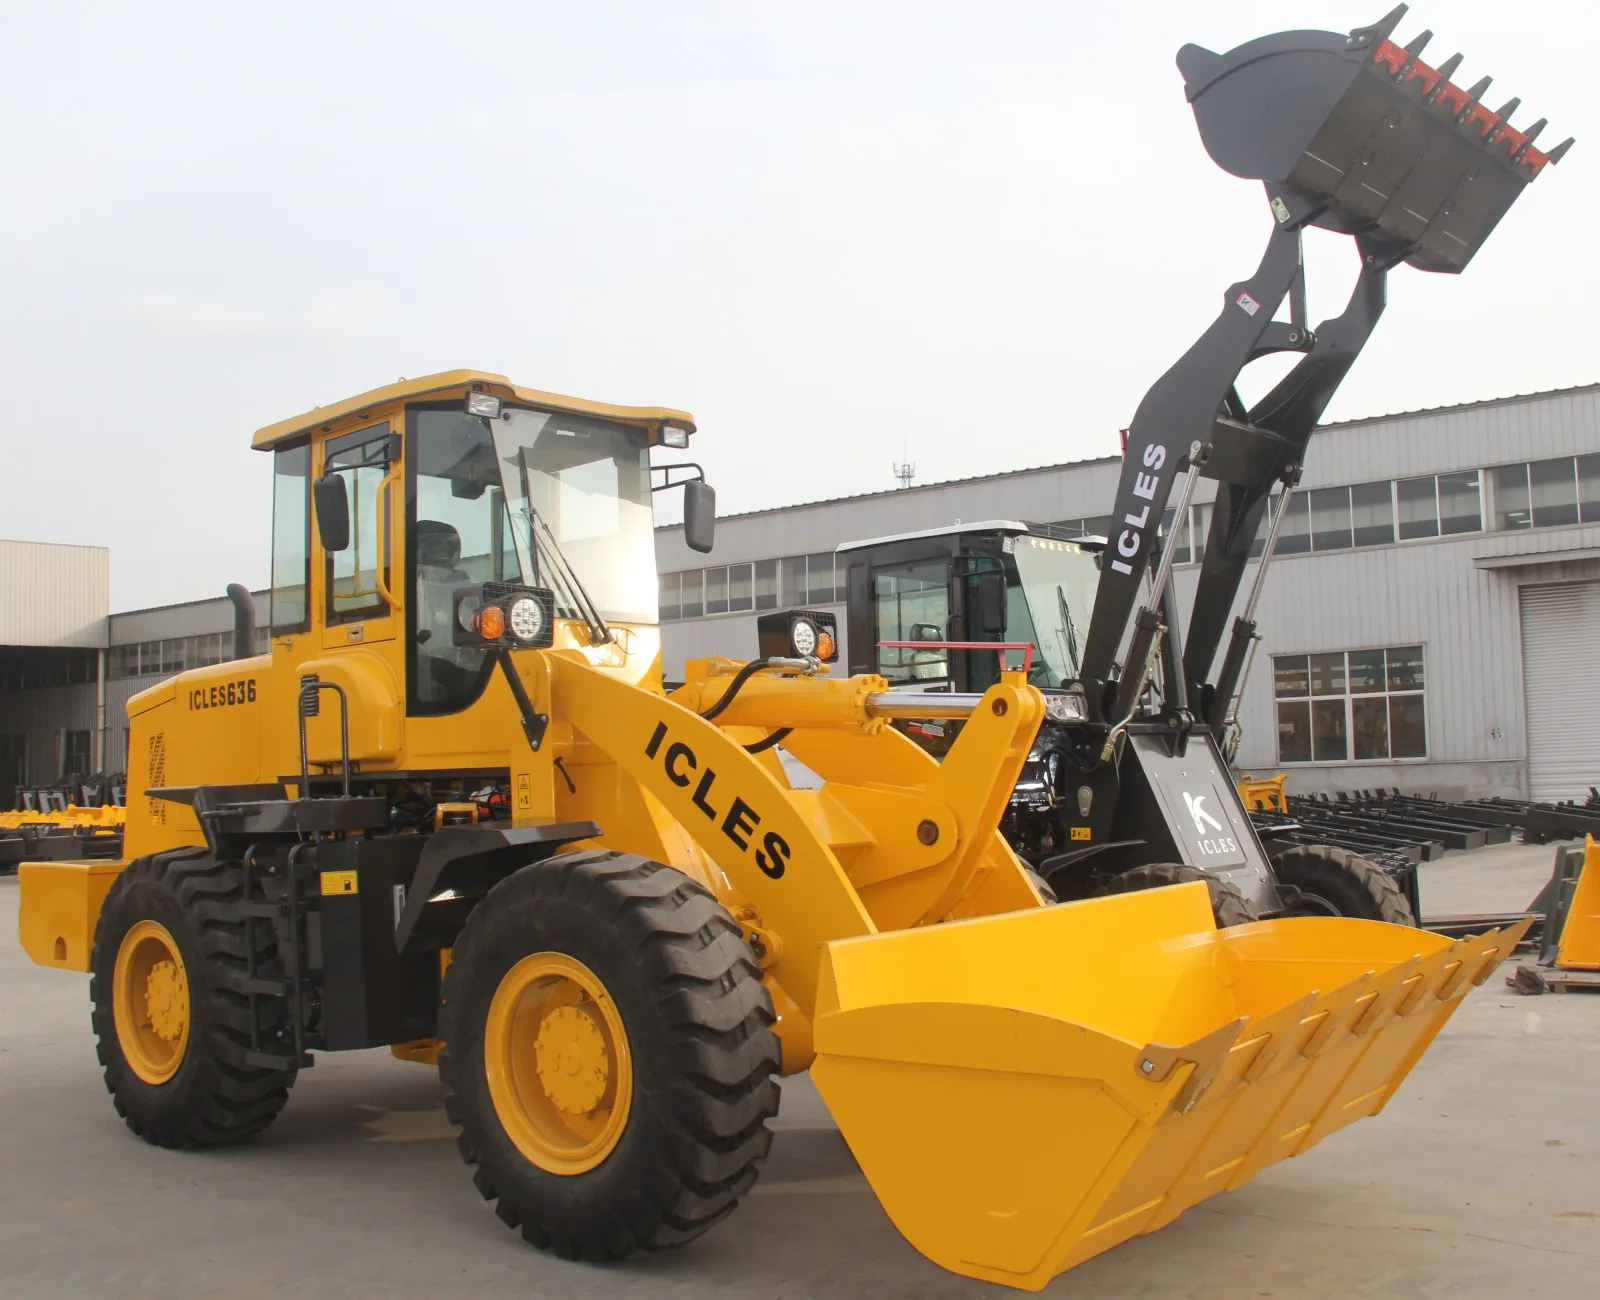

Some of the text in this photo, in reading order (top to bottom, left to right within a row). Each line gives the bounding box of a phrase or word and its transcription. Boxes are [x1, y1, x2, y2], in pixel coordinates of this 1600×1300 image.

[1111, 443, 1166, 575] ICLES
[189, 679, 256, 711] ICLES636
[645, 720, 791, 880] ICLES
[1197, 837, 1236, 855] ICLES
